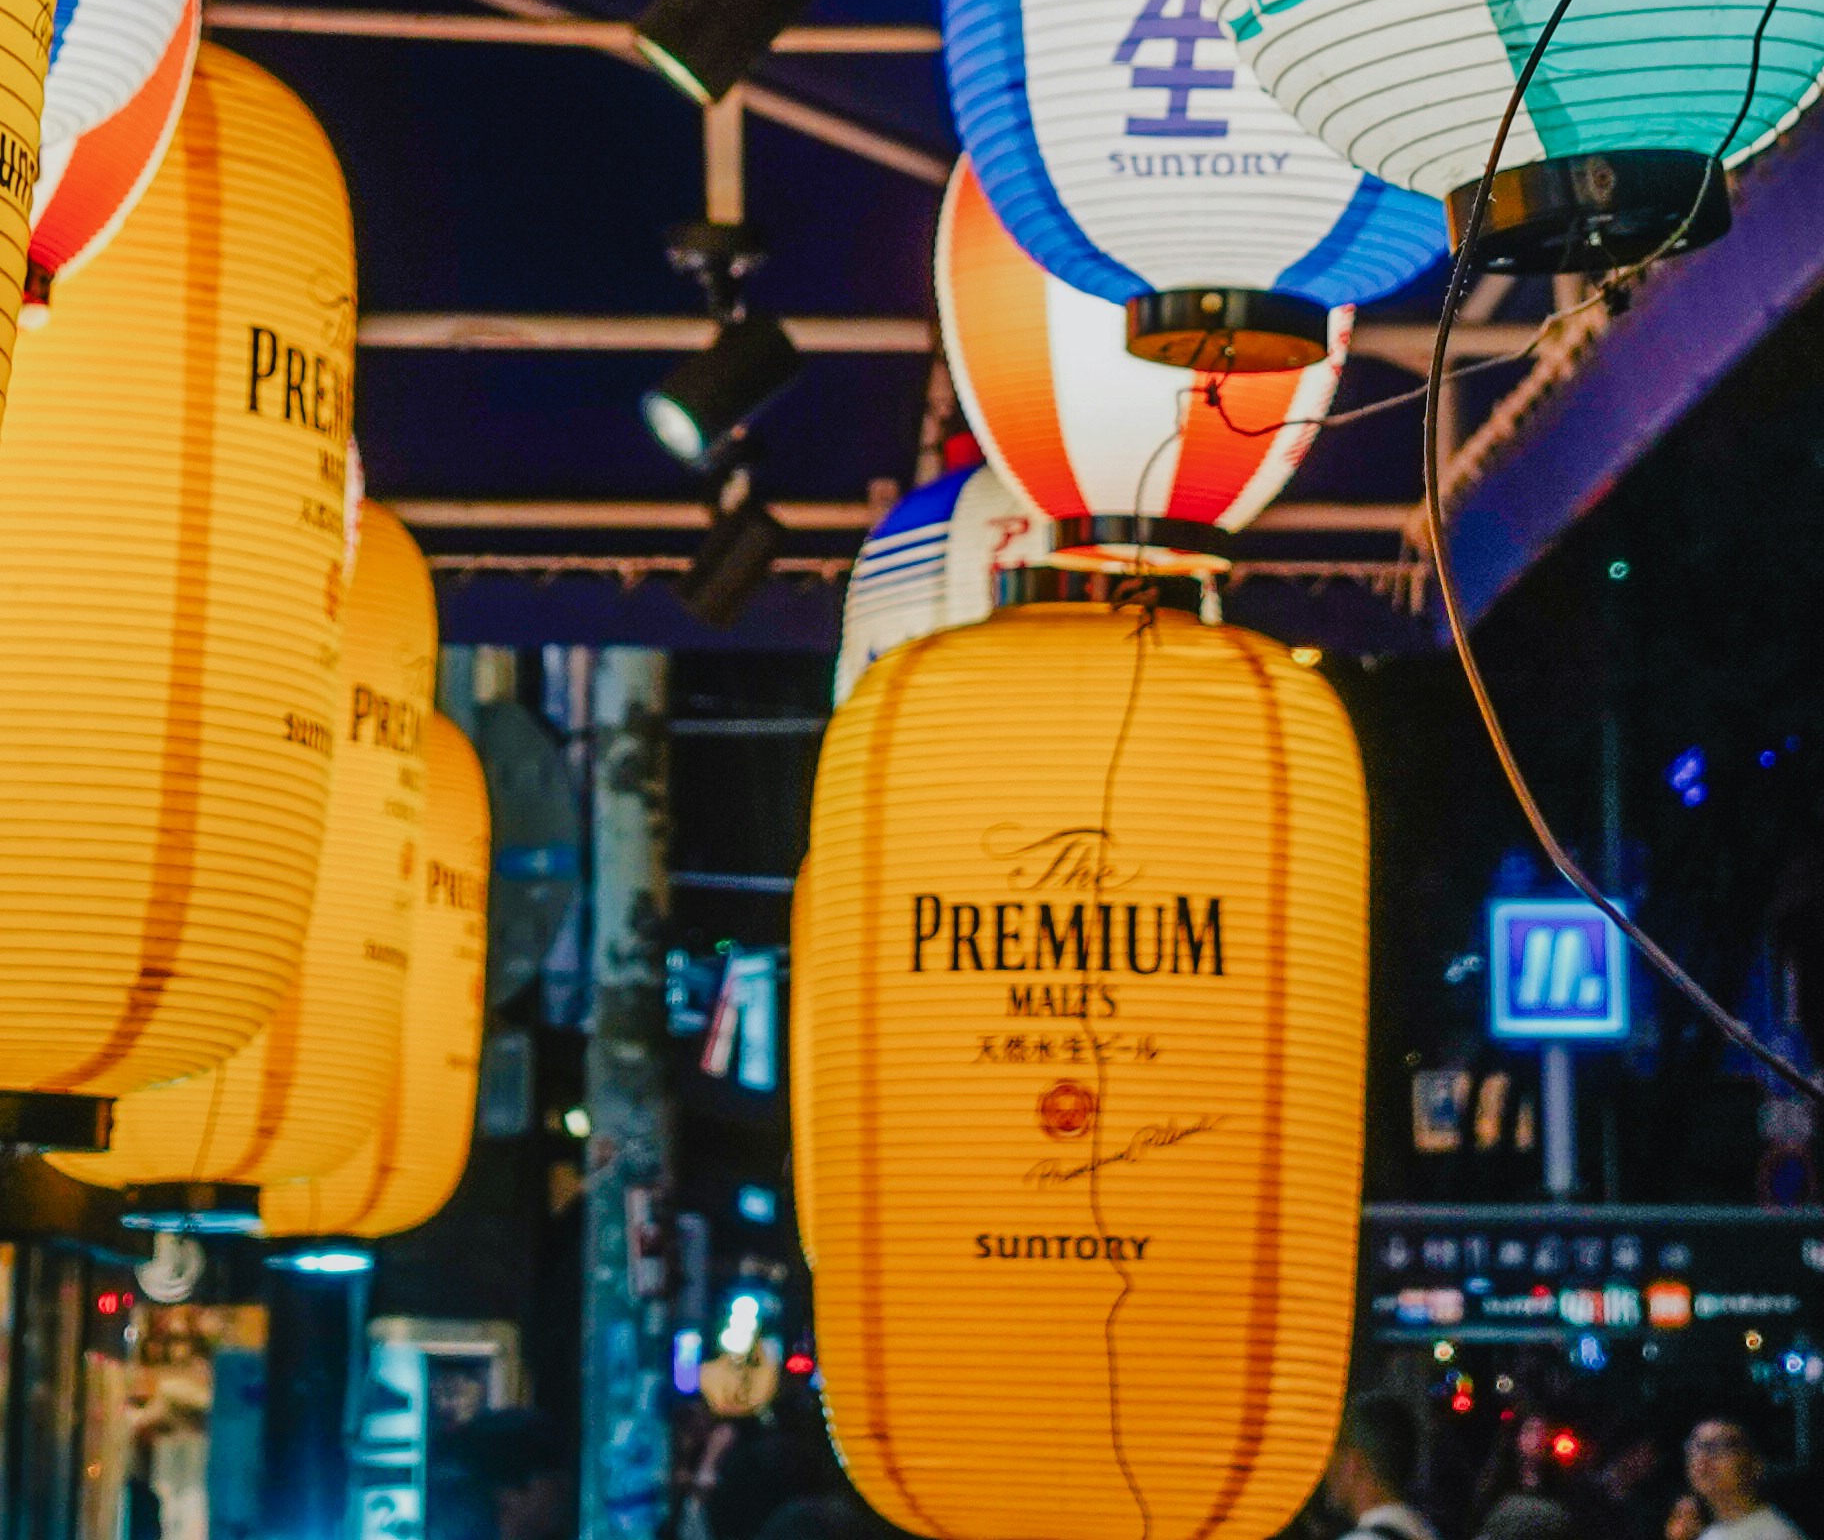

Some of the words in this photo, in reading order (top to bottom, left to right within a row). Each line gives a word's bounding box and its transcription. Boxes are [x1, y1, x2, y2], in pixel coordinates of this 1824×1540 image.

[981, 821, 1142, 891] The
[910, 894, 1226, 976] PREMIUM
[975, 1233, 1152, 1261] SUNTORY
